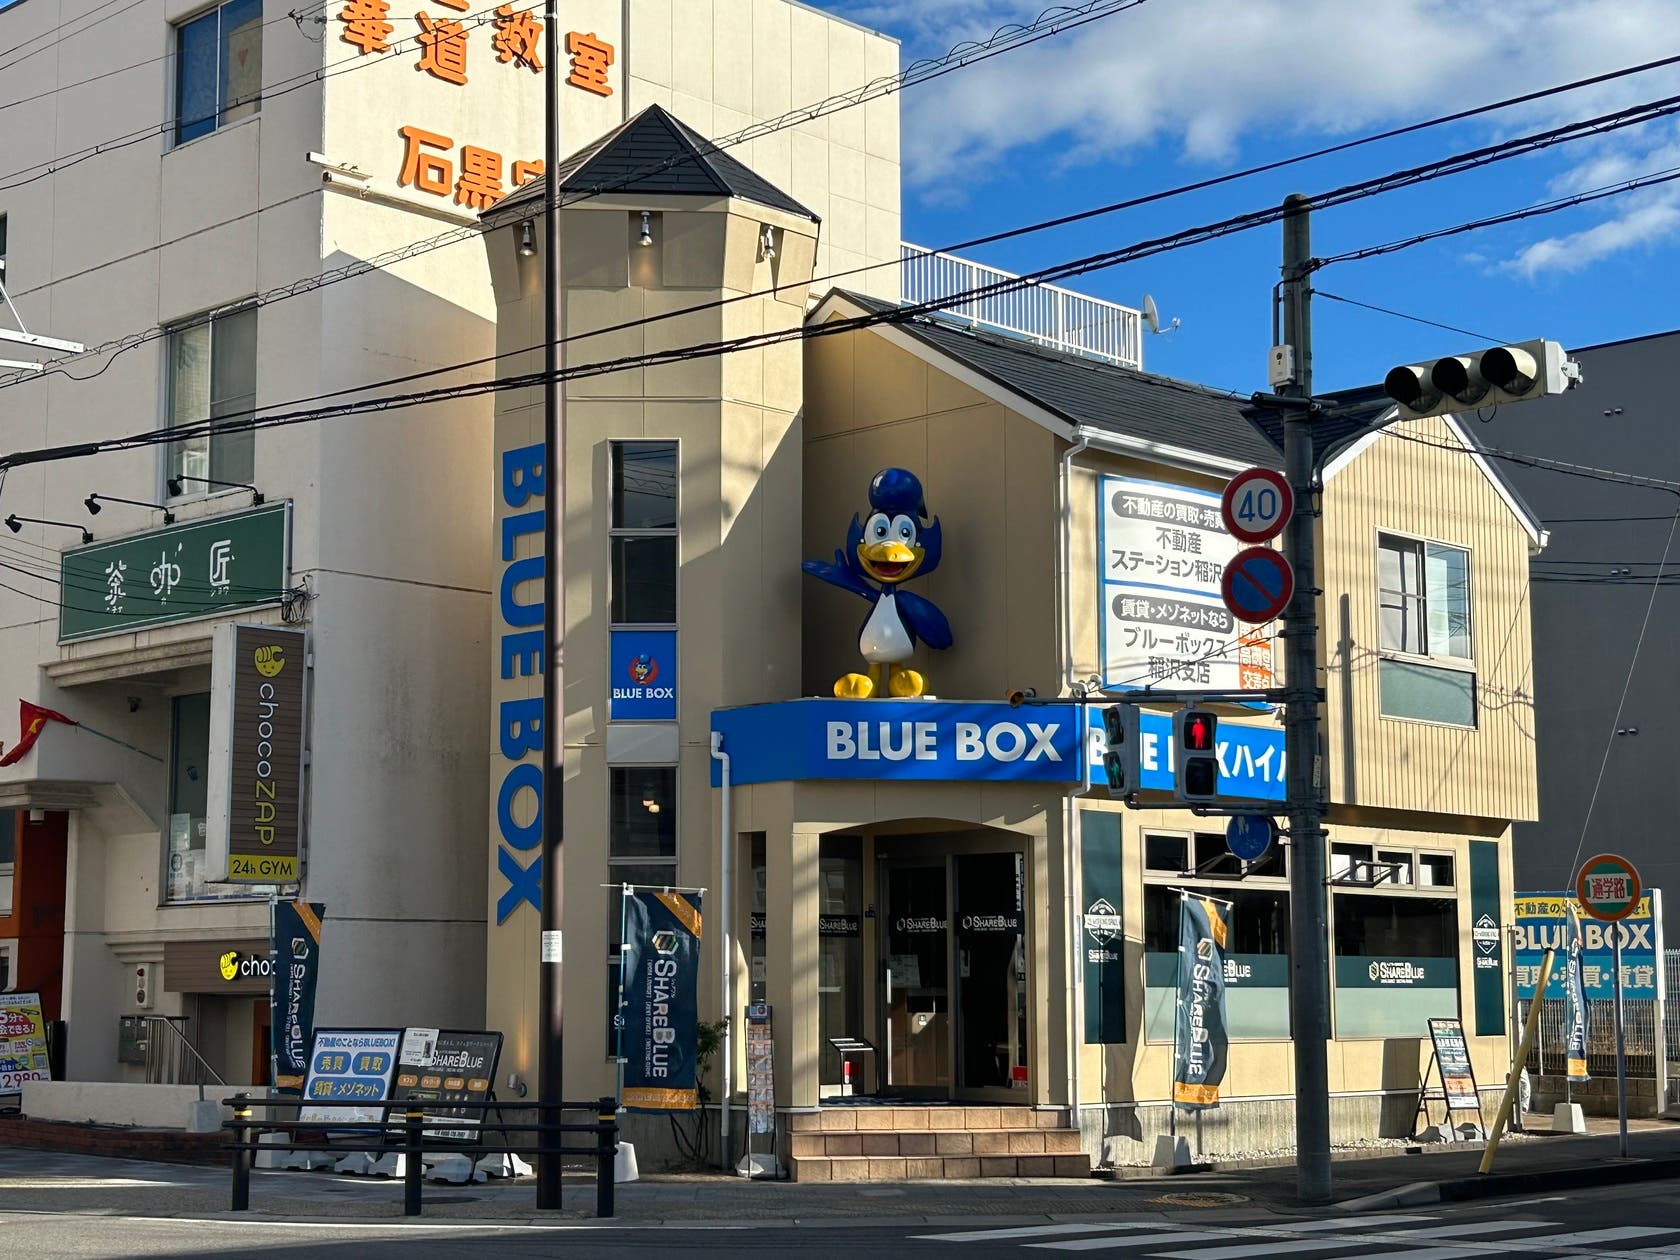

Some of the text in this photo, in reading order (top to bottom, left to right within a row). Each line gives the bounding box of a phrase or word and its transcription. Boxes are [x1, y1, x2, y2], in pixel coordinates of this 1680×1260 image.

[1238, 488, 1277, 522] 40
[1155, 526, 1202, 555] 不動産
[1112, 549, 1227, 584] ステーション稲沢
[1120, 599, 1228, 630] 賃貸・メゾネットなら
[1123, 625, 1228, 660] ブルーボックス
[497, 443, 546, 927] BLUE BOX
[1148, 656, 1211, 685] 稲沢支店
[613, 687, 673, 700] BLUE BOX
[826, 721, 1063, 763] BLUE BOX
[255, 682, 280, 846] chocoZAP
[232, 859, 293, 876] 24h GYM
[1591, 876, 1626, 900] 通学路
[1585, 924, 1653, 950] BOX
